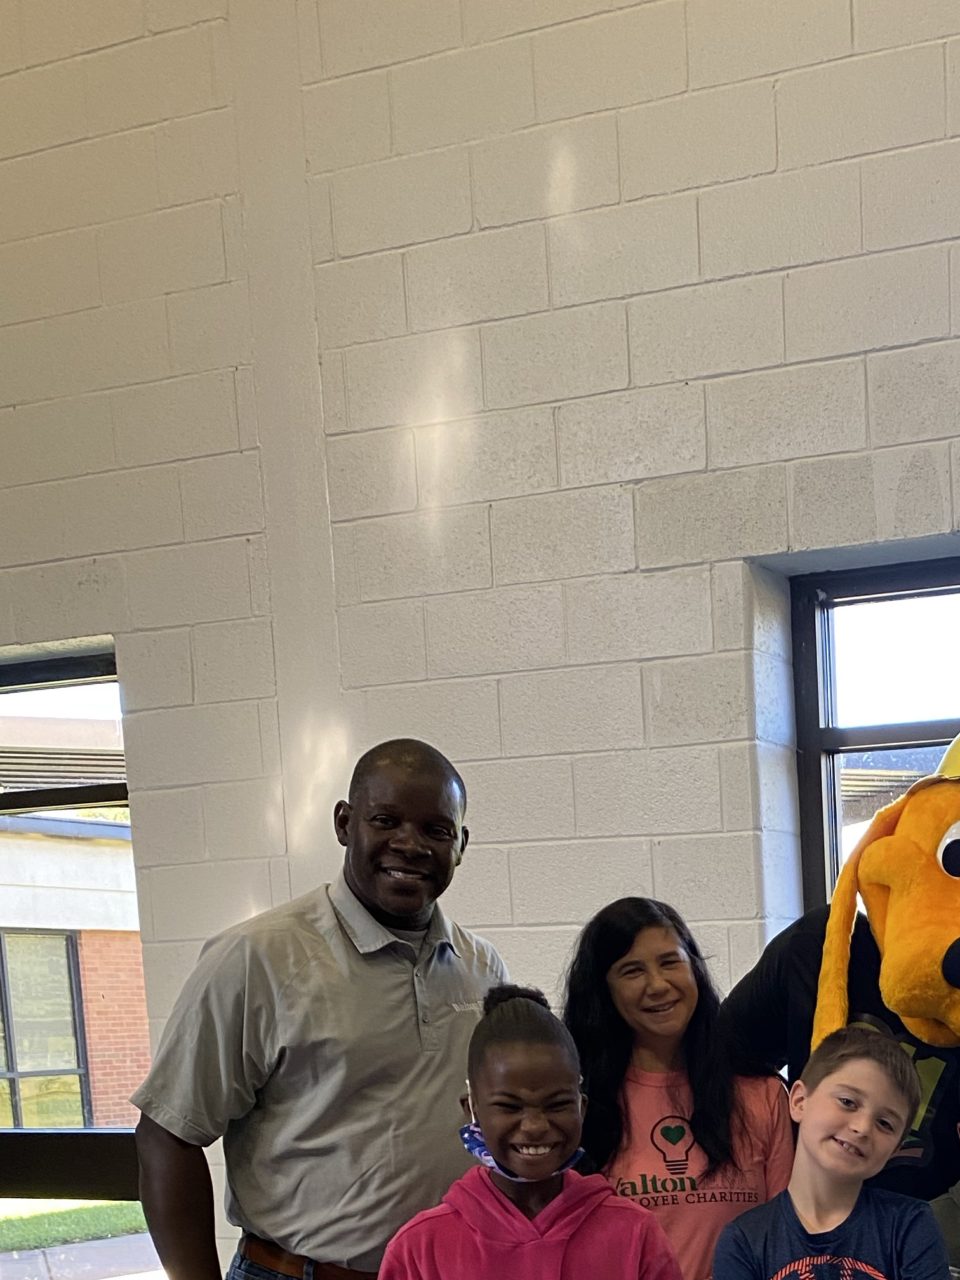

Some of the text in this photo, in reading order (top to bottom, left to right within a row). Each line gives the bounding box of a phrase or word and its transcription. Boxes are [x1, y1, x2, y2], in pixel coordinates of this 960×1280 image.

[616, 1173, 699, 1196] alton
[631, 1190, 759, 1208] OYEE CHARITIES
